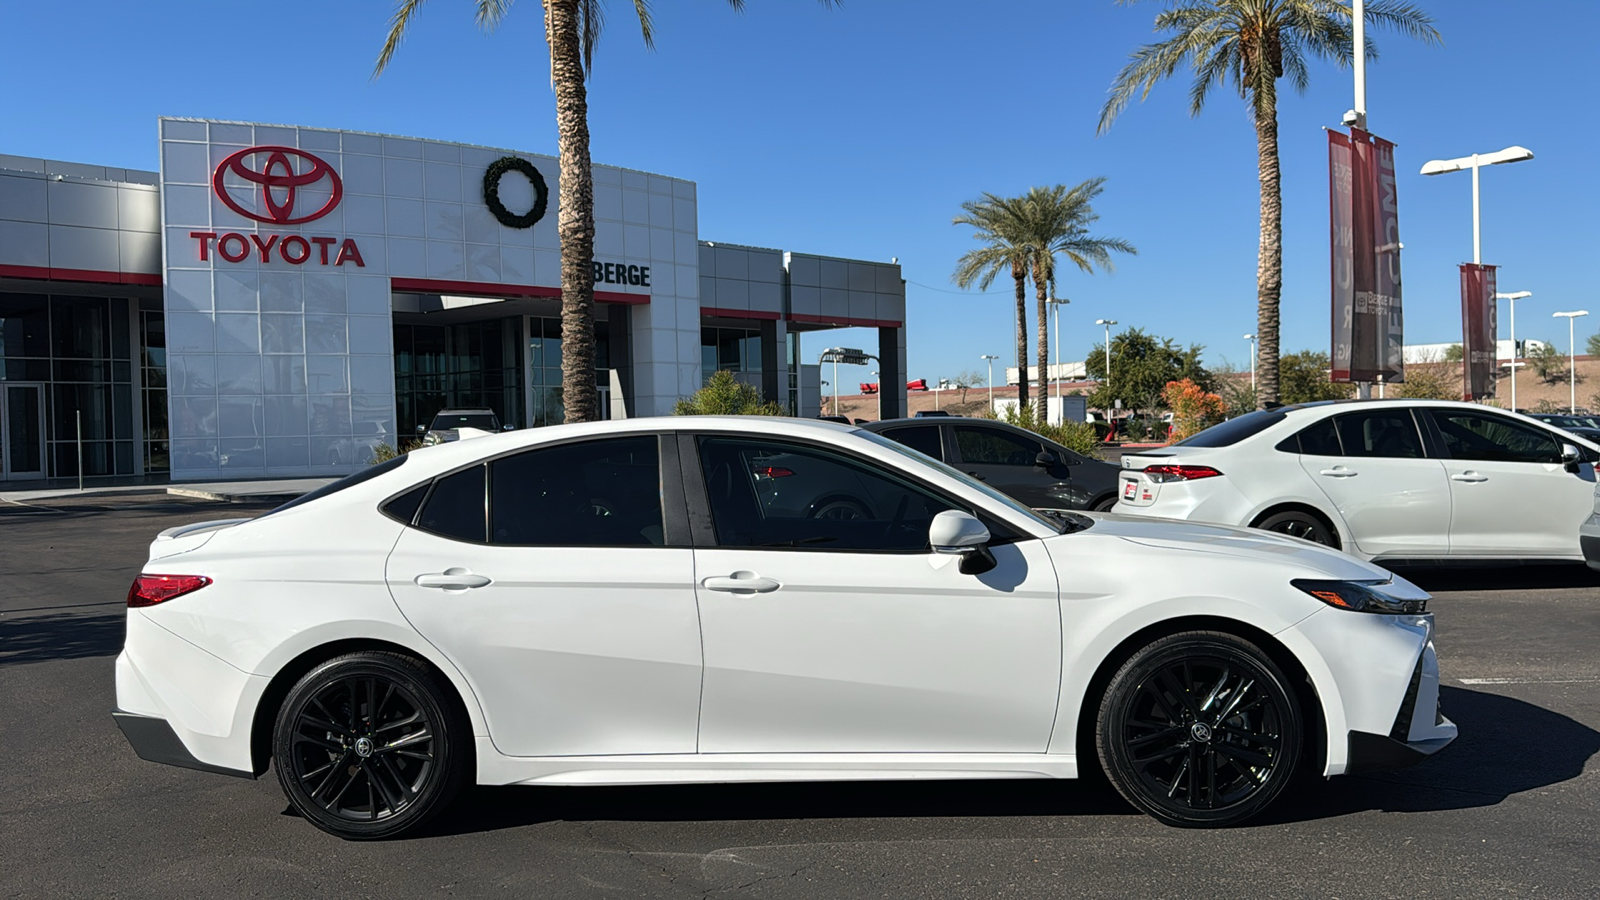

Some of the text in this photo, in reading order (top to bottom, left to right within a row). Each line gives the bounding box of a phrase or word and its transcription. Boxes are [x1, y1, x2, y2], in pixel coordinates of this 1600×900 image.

[190, 232, 366, 267] TOYOTA
[591, 261, 650, 287] BERGE
[1367, 291, 1388, 306] BERGE
